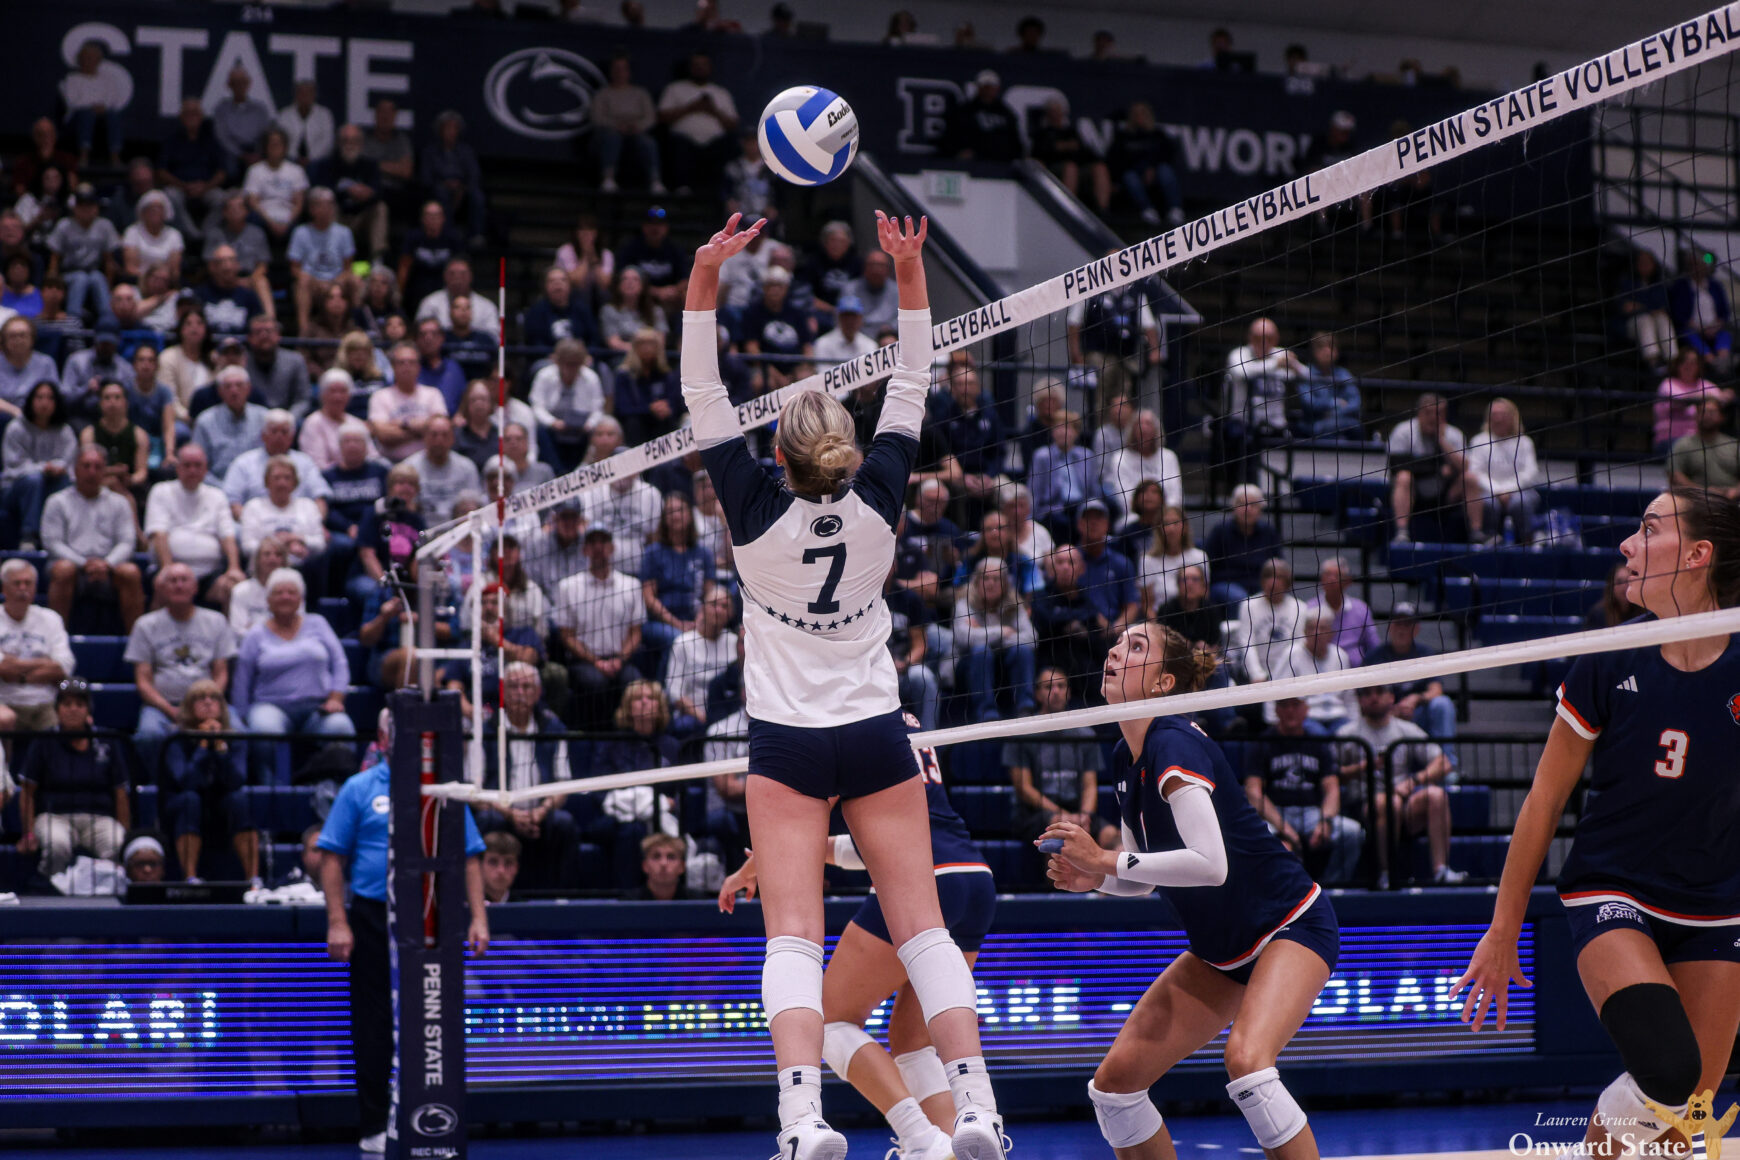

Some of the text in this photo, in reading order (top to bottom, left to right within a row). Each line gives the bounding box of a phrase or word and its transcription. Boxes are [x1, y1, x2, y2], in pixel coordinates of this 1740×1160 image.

[61, 22, 414, 128] STATE
[1396, 115, 1466, 169] PENN
[1472, 78, 1558, 138] STATE
[1064, 176, 1320, 299] PENN STATE VOLLEYBALL
[824, 299, 1012, 393] PENN STAT LLEYBALL
[644, 388, 783, 462] PENN STA EYBALL
[530, 483, 557, 507] STATE
[557, 460, 615, 496] VOLLEYBALL
[802, 542, 847, 614] 7
[1654, 728, 1690, 779] 3
[422, 963, 443, 1086] PENN STATE
[410, 1147, 459, 1158] REC HALL
